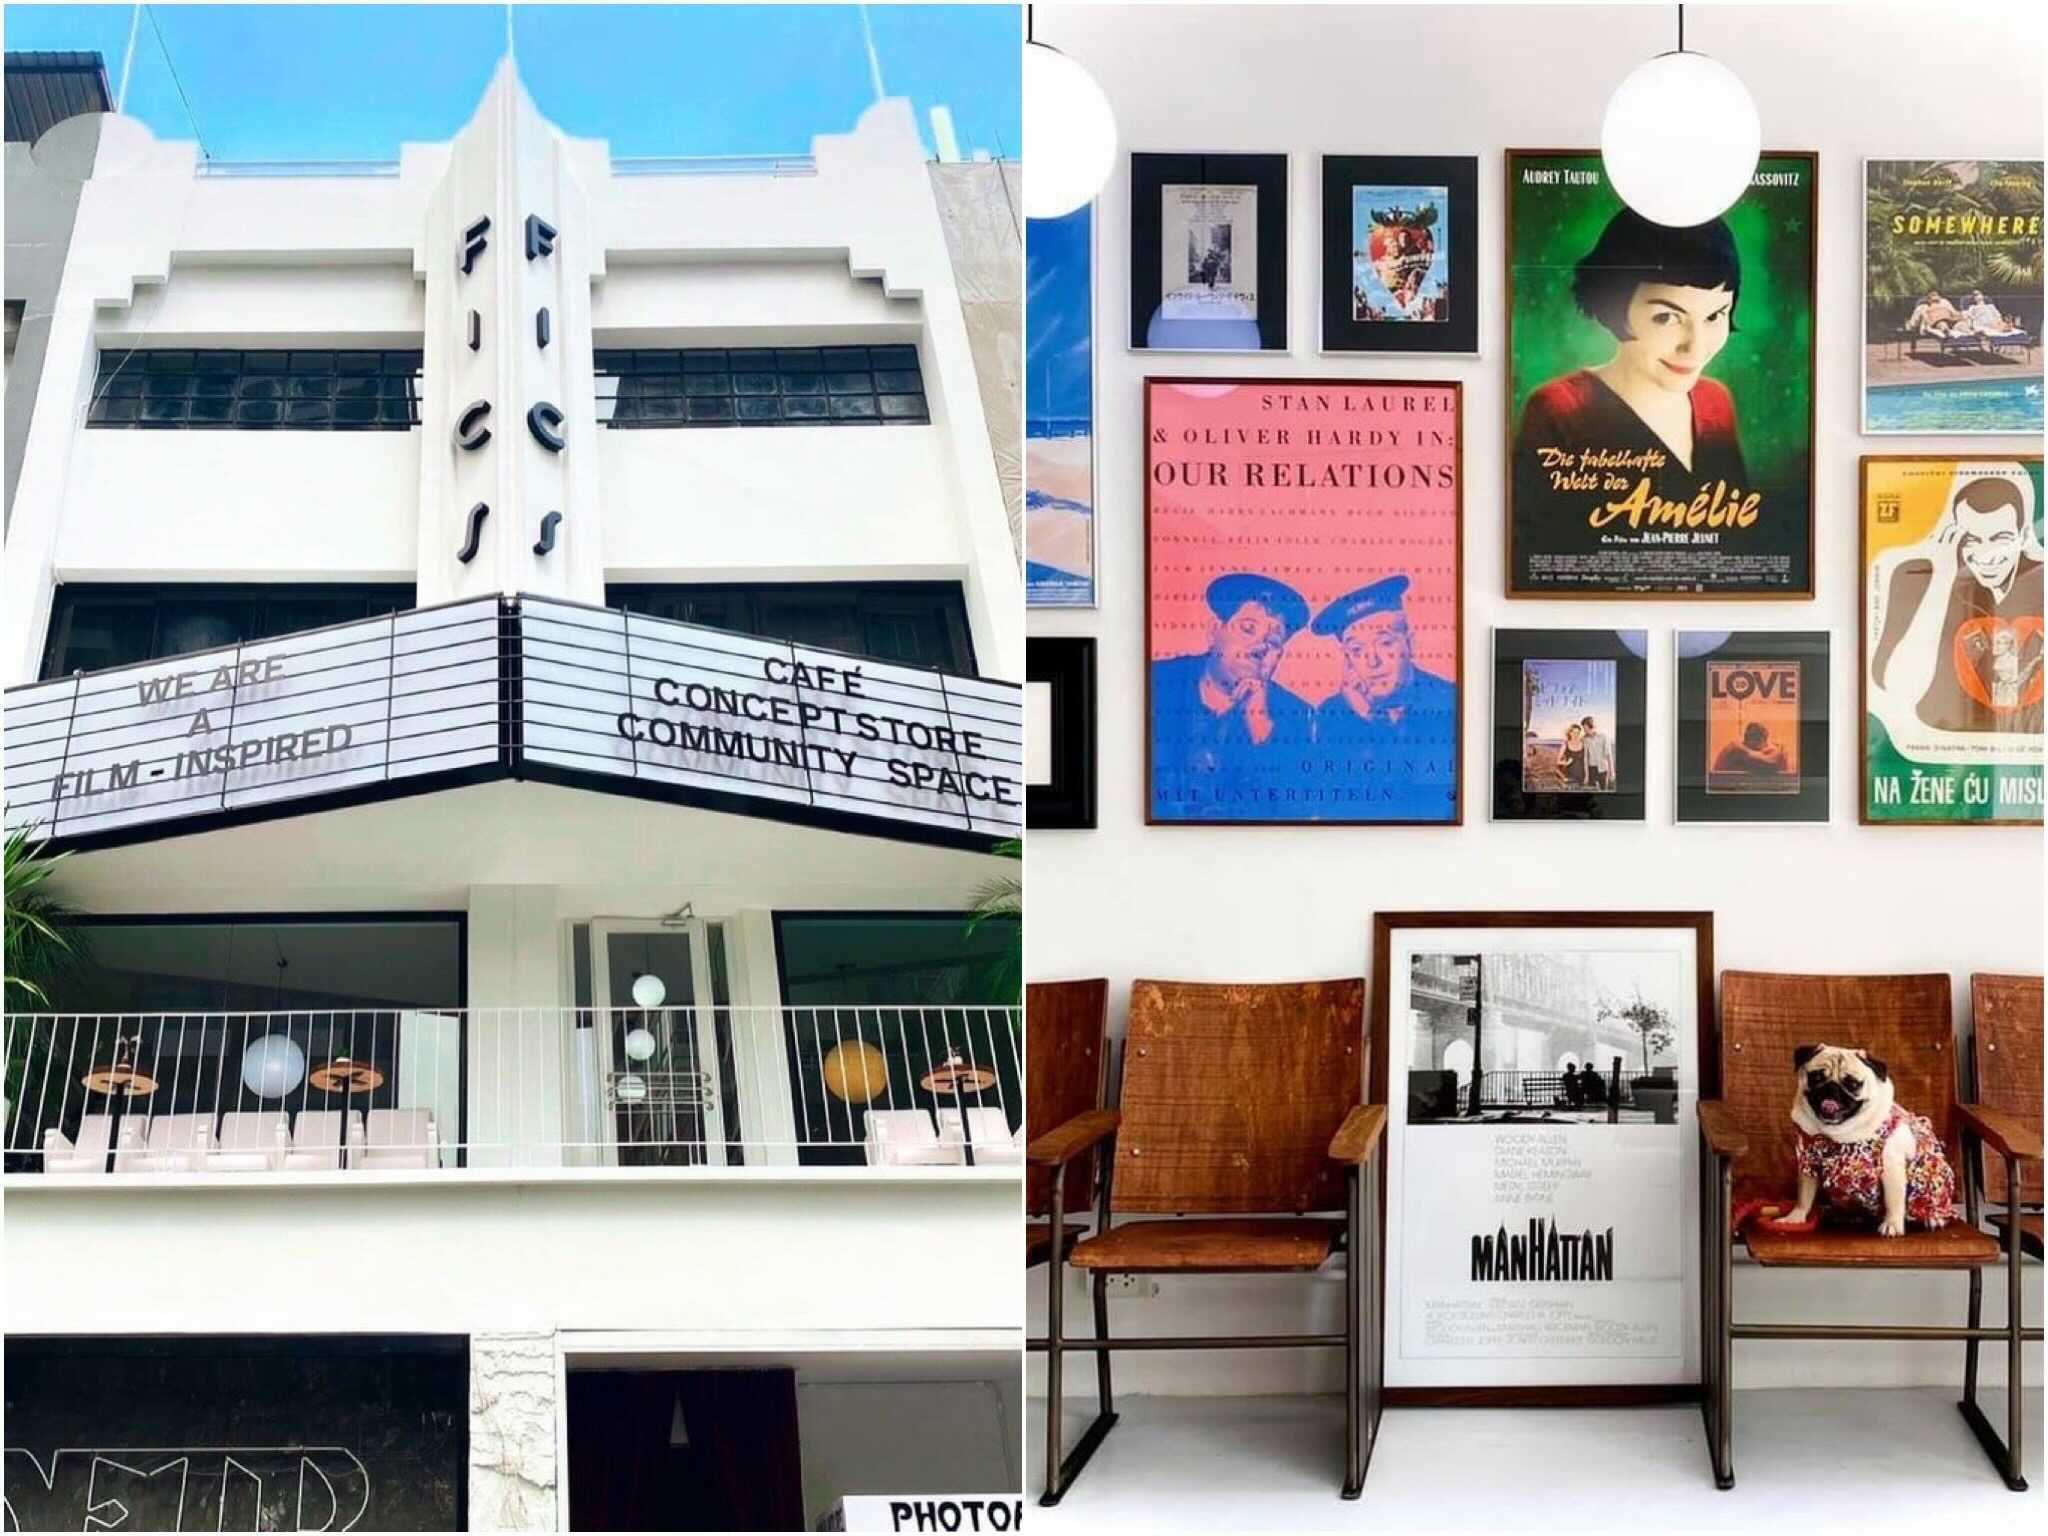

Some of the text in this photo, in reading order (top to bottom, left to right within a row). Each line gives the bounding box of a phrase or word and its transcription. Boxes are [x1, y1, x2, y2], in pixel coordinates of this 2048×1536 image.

[1523, 168, 1599, 184] AUDREY TAUTOU
[1749, 172, 1799, 186] ASSOVITZ
[1892, 215, 2041, 235] SOMEWHERE
[1261, 394, 1456, 412] STAN LAUREL
[1152, 428, 1455, 447] & OLIVER HARDY IN:
[1537, 447, 1666, 472] Die fabelhafte
[1153, 461, 1455, 489] OUR RELATIONS
[1550, 471, 1629, 491] Welt der
[1589, 478, 1761, 529] Amélie
[137, 654, 288, 706] WE ARE
[764, 656, 863, 700] CAFÉ
[1711, 671, 1796, 700] LOVE
[186, 706, 214, 738] A
[654, 677, 986, 760] CONCEPT STORE
[52, 758, 141, 800] FILM
[175, 723, 354, 780] INSPIRED
[617, 712, 1018, 807] COMMUNITY SPACE
[1874, 776, 1901, 804] NA
[1910, 769, 1955, 805] ŽENE
[1963, 772, 1989, 805] ĆU
[1471, 1214, 1614, 1282] MANHATTAN
